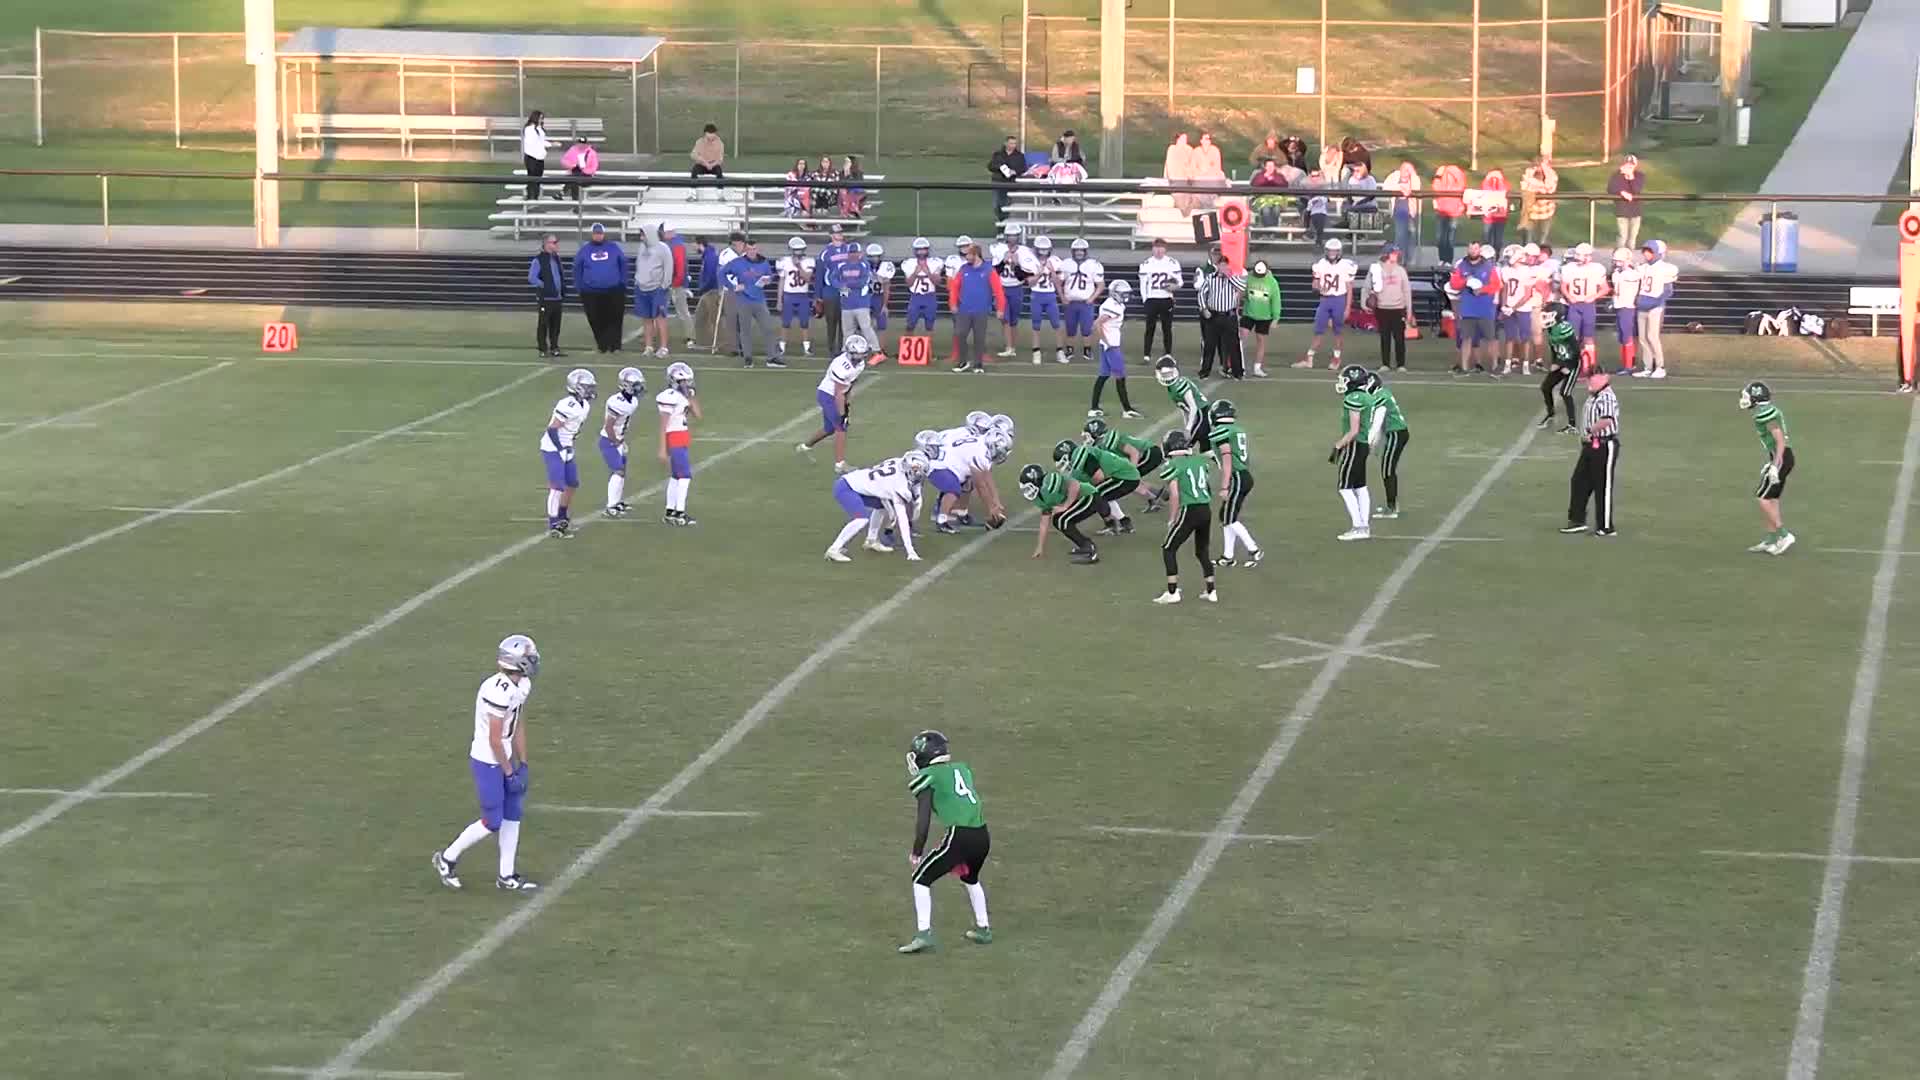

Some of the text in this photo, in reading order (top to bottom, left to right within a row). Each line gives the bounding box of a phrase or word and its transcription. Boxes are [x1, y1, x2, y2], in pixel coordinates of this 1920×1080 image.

[1199, 215, 1213, 238] 1
[1070, 272, 1087, 290] 76
[1572, 278, 1588, 297] 51
[266, 325, 289, 348] 20
[901, 337, 924, 361] 30
[1187, 464, 1212, 503] 14
[952, 768, 977, 805] 4
